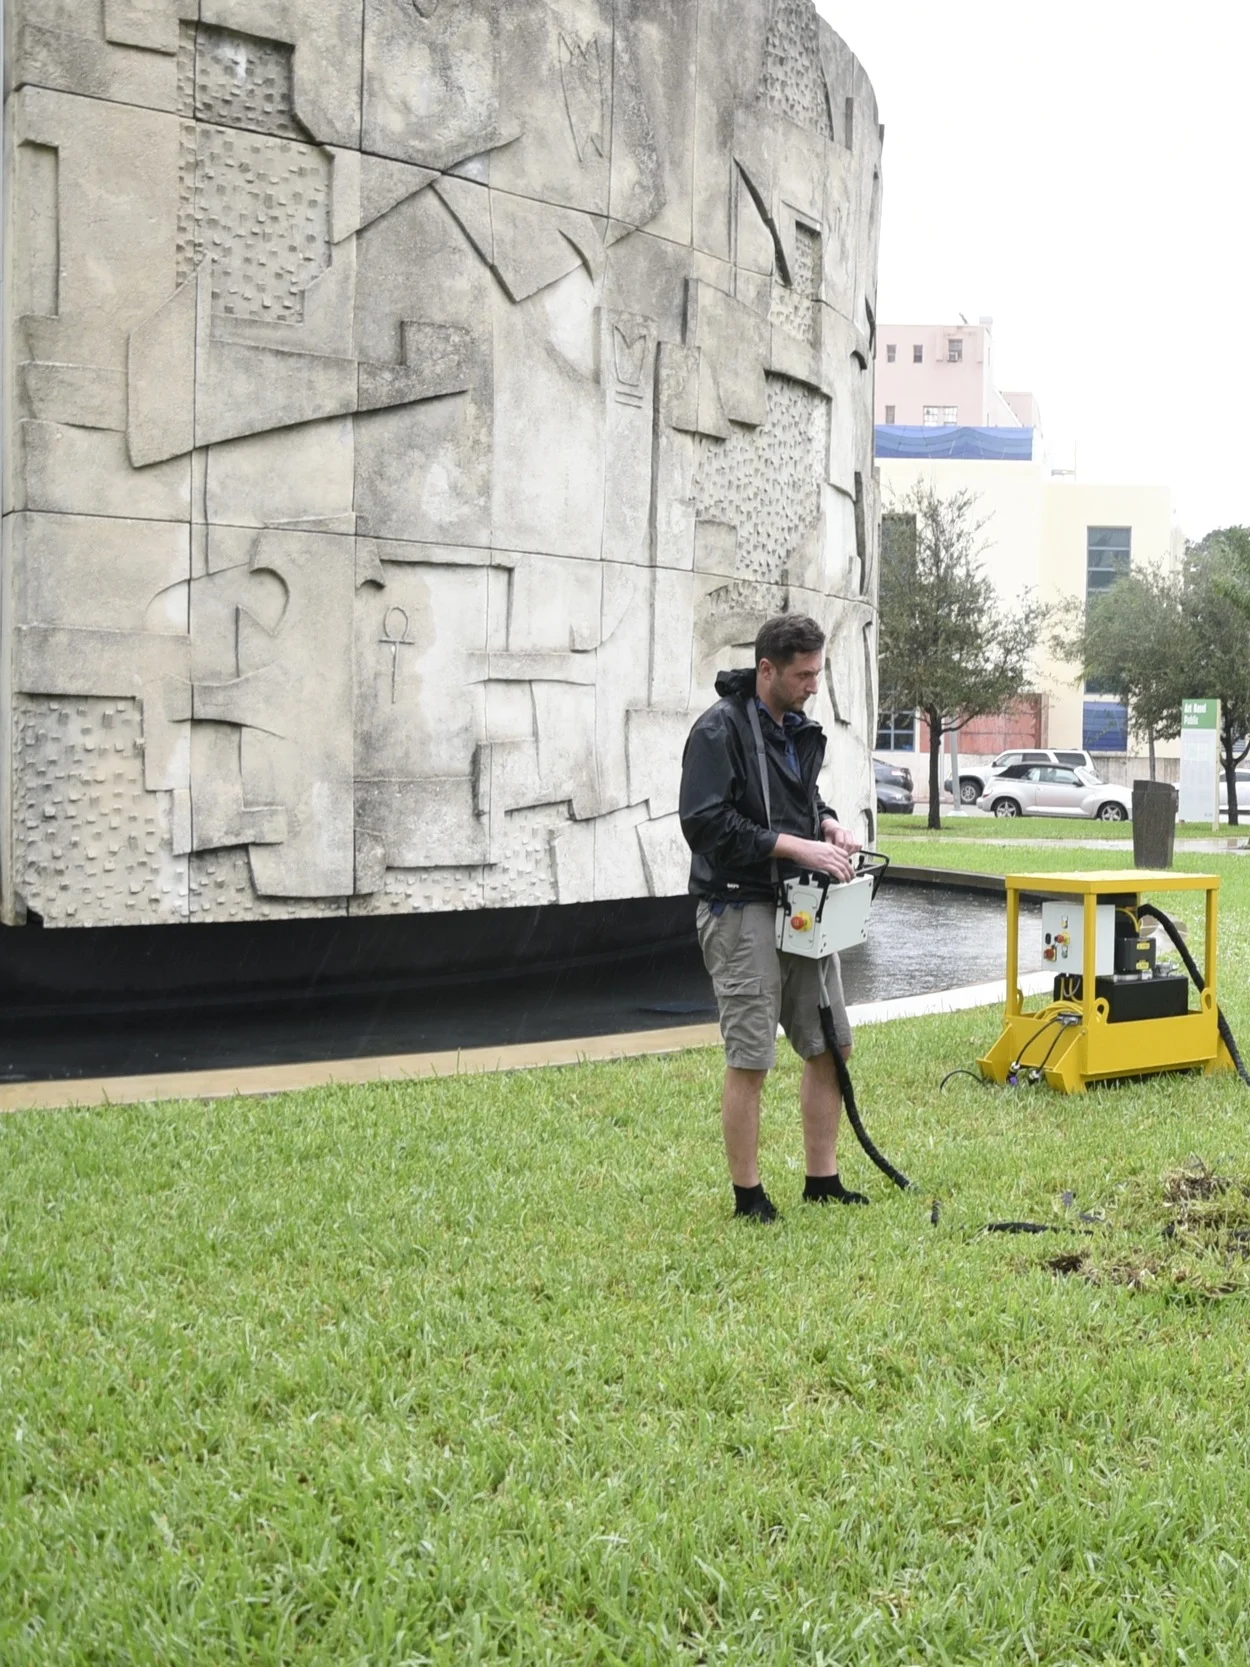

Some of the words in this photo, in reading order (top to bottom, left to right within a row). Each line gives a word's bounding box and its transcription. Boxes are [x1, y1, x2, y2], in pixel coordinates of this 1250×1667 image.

[1184, 703, 1192, 713] Art
[1193, 702, 1207, 713] Basel
[1183, 714, 1199, 725] Public
